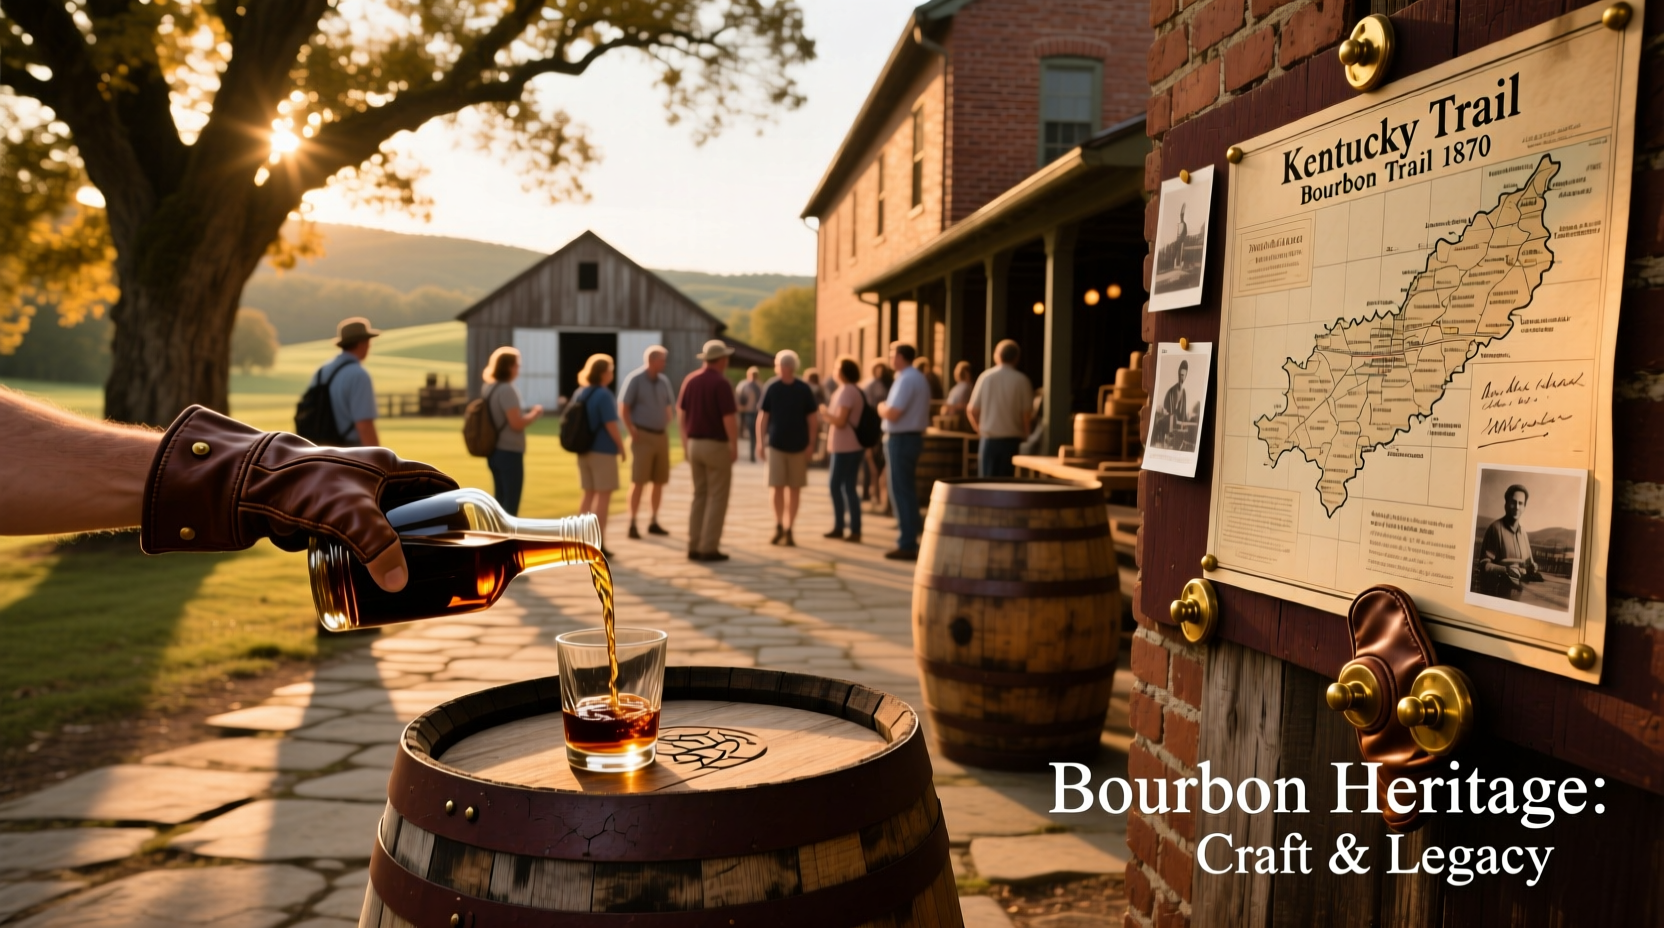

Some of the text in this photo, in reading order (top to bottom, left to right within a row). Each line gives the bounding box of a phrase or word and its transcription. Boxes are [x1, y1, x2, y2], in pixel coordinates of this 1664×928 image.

[1281, 116, 1420, 185] Kentucky
[1429, 72, 1522, 138] Trail
[1300, 169, 1377, 206] Bourbon
[1385, 150, 1432, 183] Trail
[1442, 134, 1492, 168] 1870
